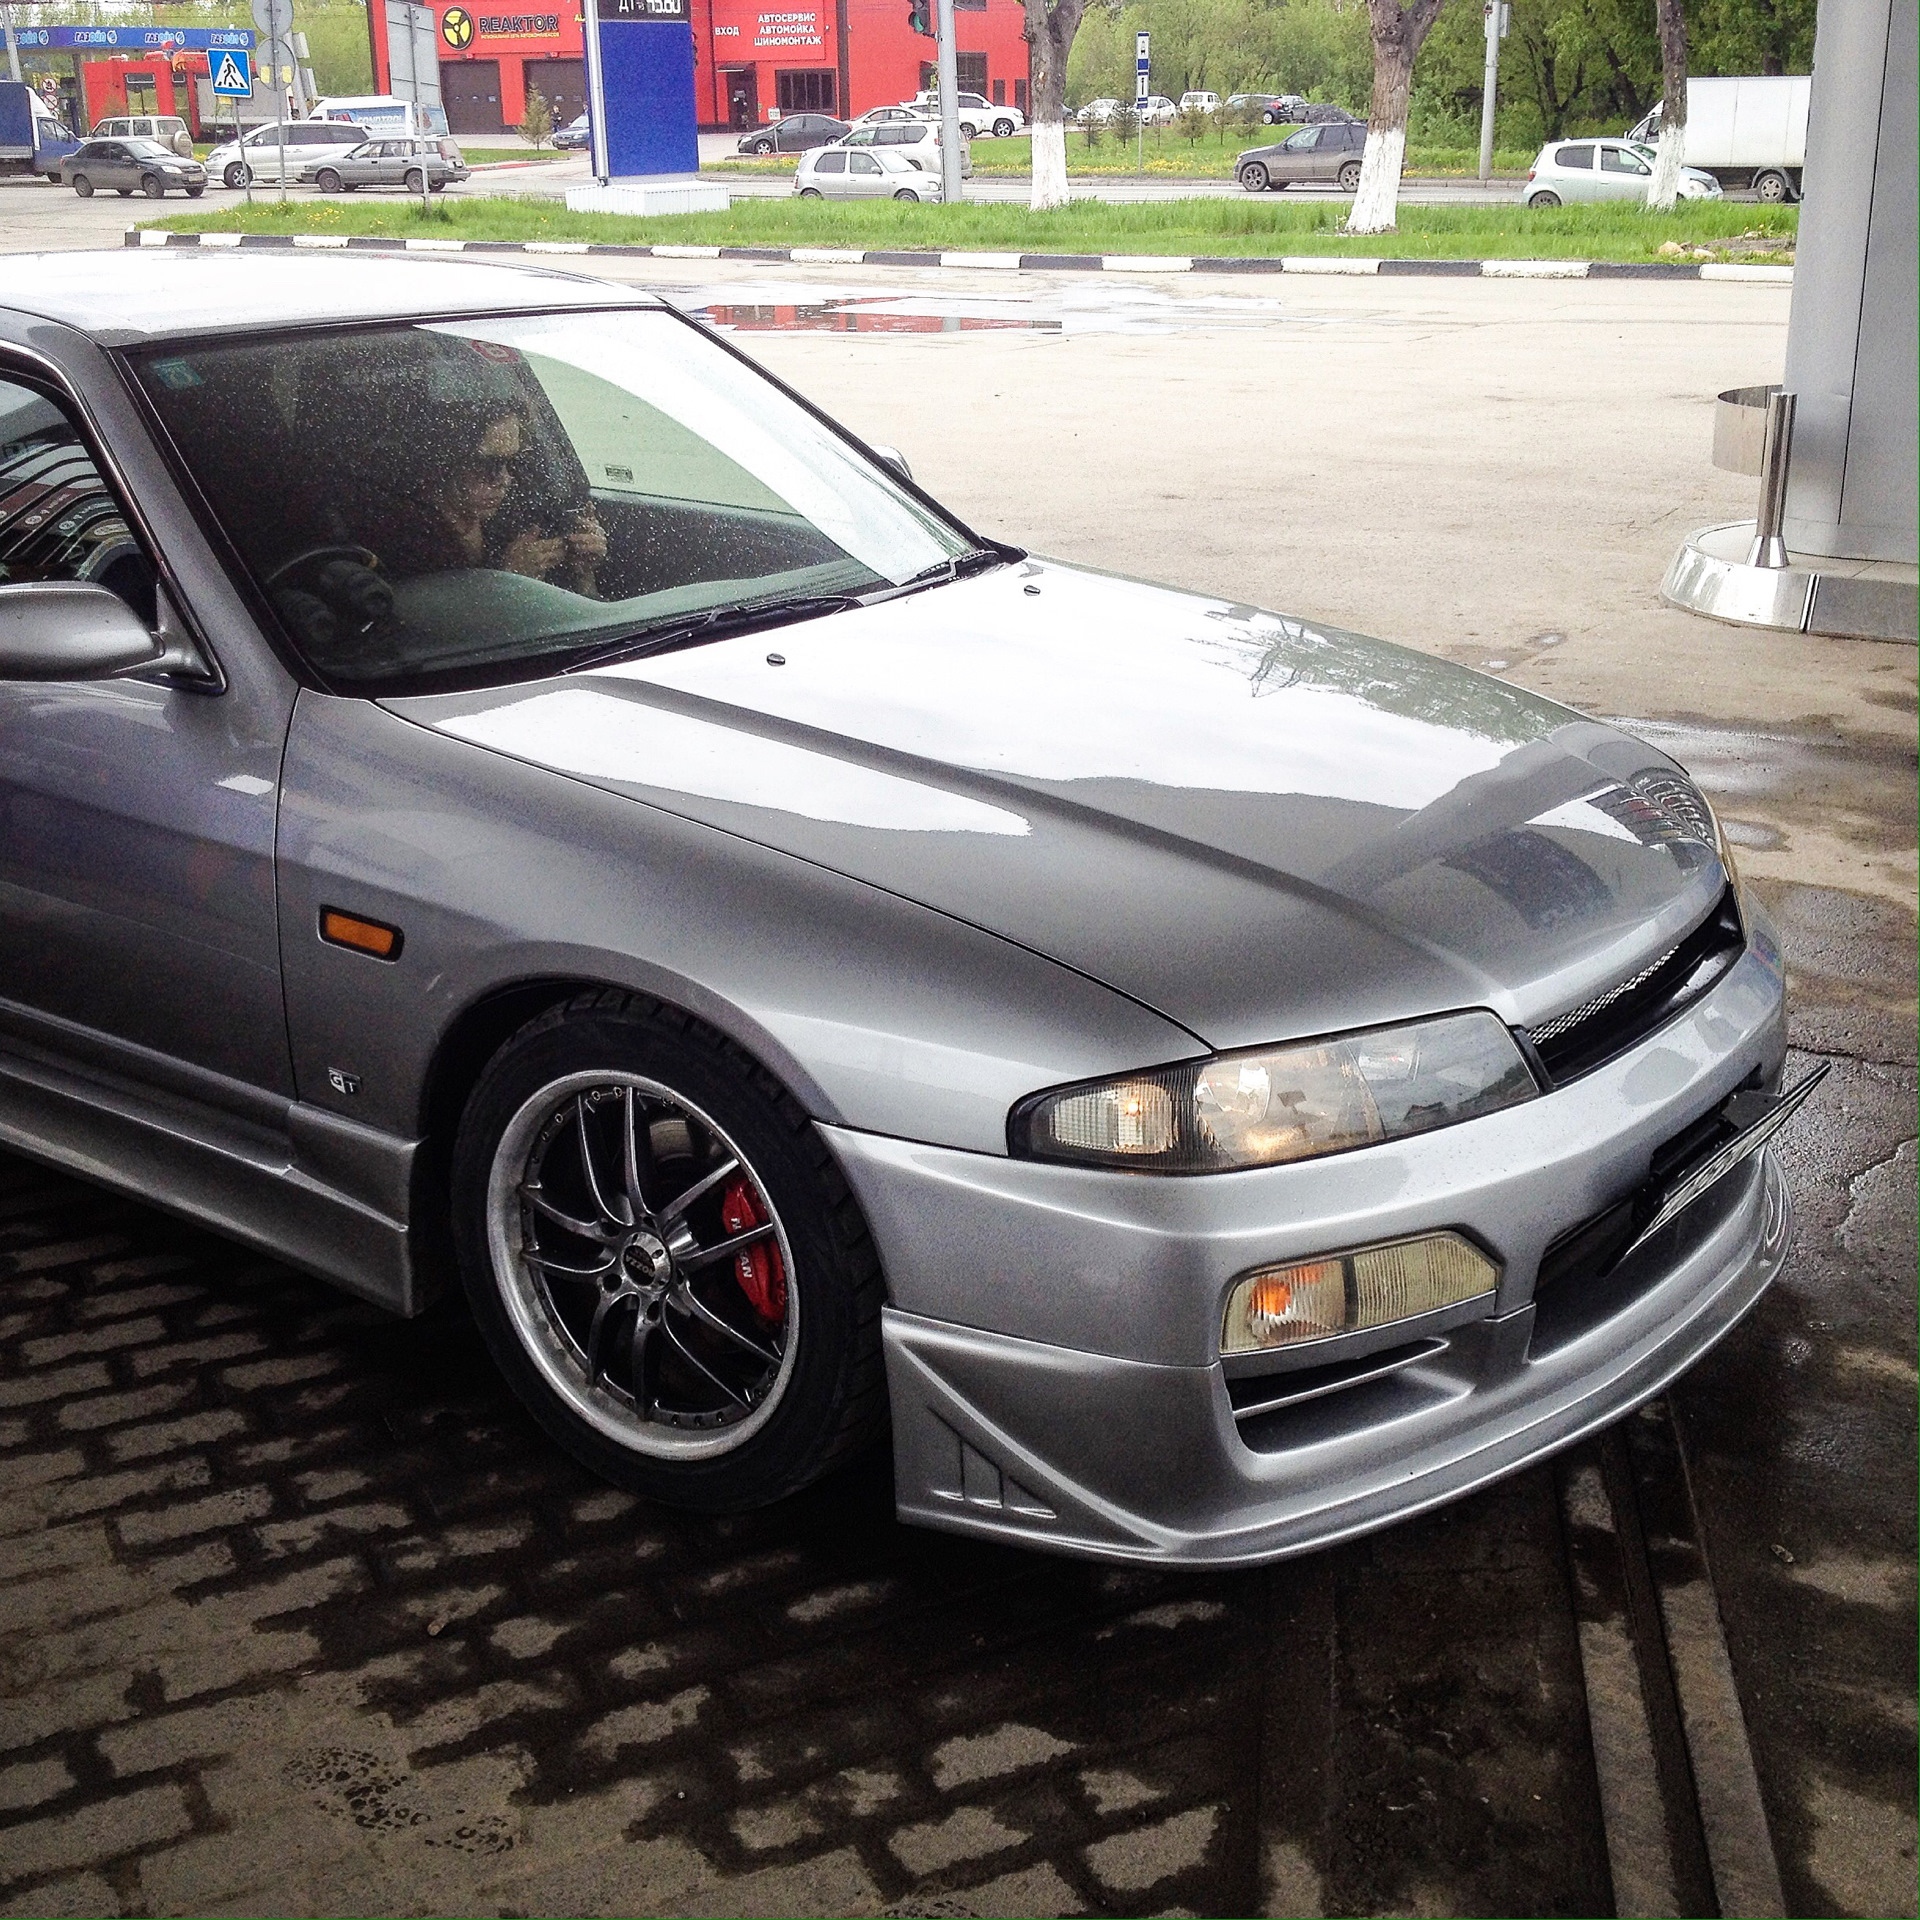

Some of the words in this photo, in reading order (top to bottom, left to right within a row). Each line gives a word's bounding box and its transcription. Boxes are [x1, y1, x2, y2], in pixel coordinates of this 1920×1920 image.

[757, 13, 816, 23] АВТОСЕРВИС
[479, 14, 558, 33] REAKTOR
[714, 26, 740, 36] ВХОД
[759, 23, 816, 35] АВТОМОЙКА
[754, 36, 822, 46] ШИНОМОНТАЖ
